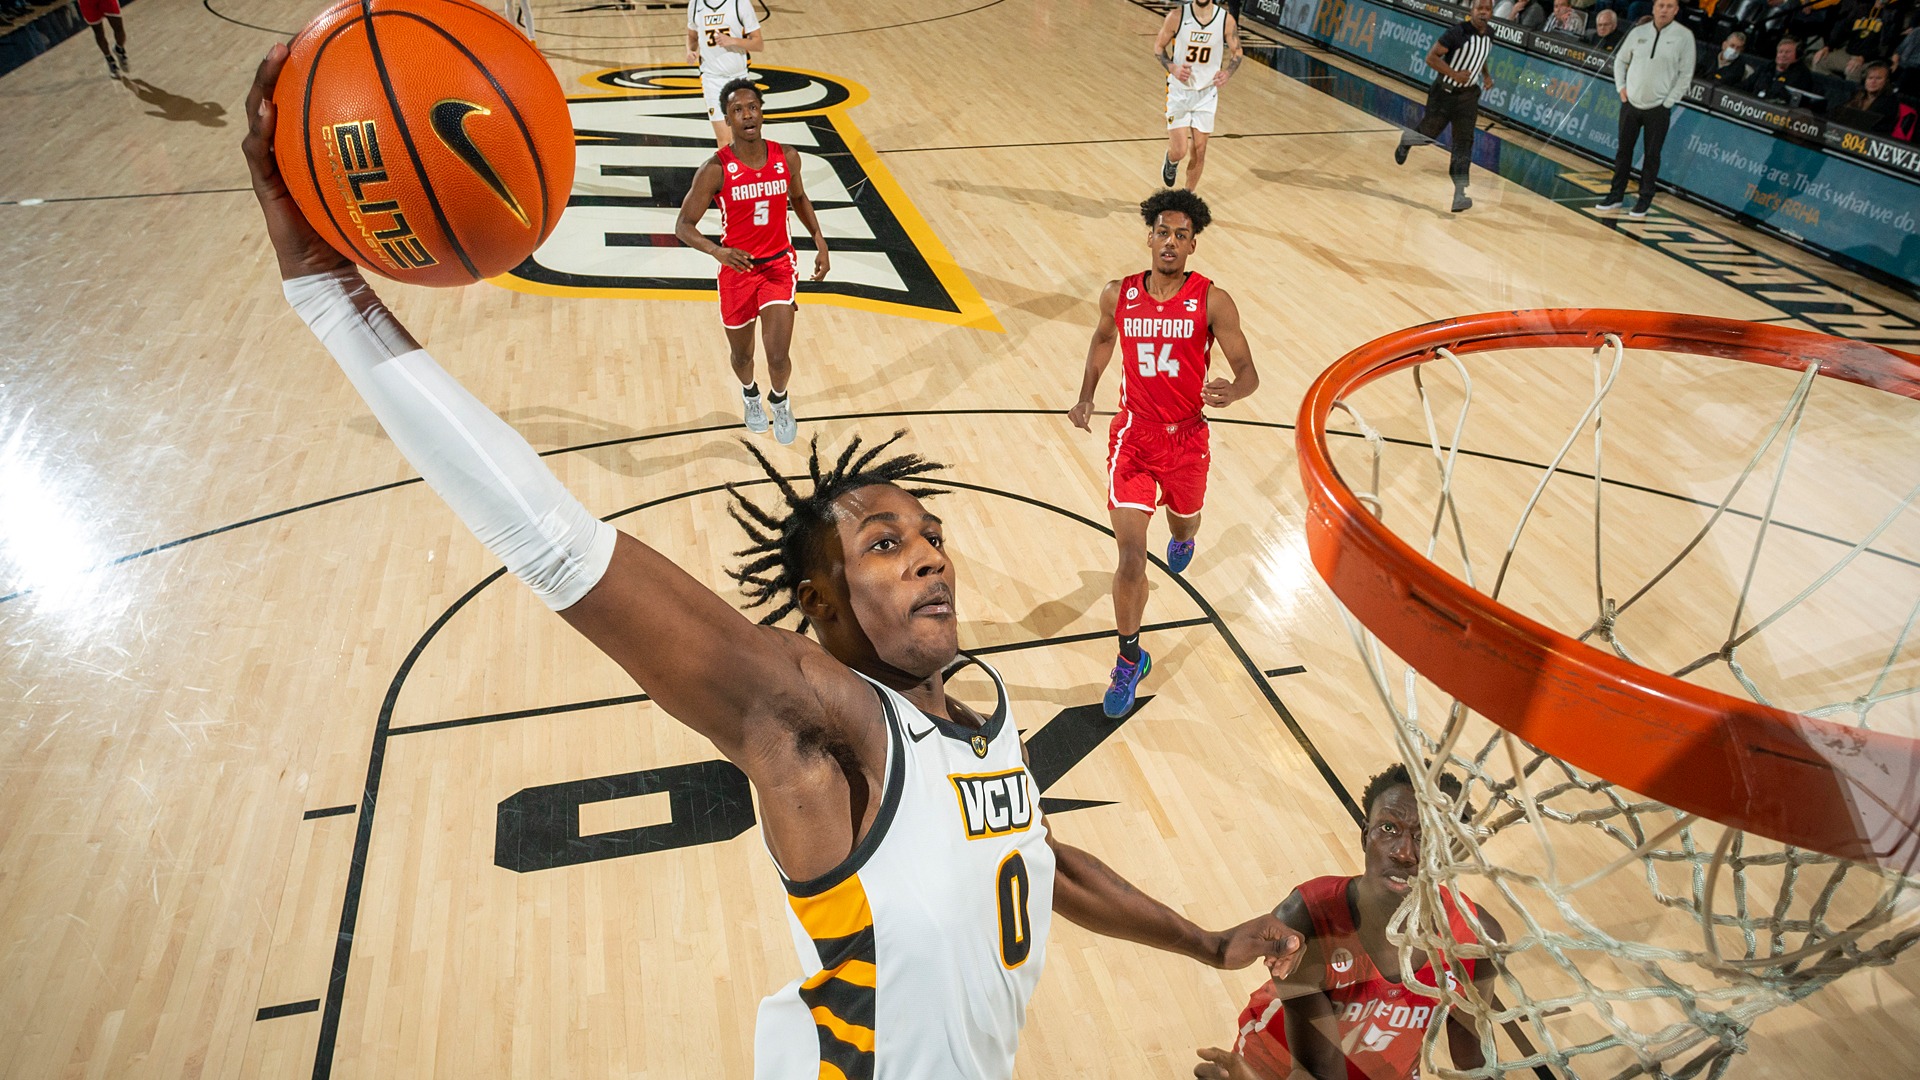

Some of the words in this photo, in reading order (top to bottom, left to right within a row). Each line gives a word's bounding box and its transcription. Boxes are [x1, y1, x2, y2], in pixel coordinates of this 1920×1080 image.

[704, 14, 725, 26] VCU
[1190, 31, 1212, 43] VCU
[1312, 0, 1377, 53] RRHA
[1379, 19, 1434, 51] provides
[1185, 45, 1211, 63] 30
[1534, 37, 1606, 68] findyournest.com
[1545, 77, 1583, 105] and
[1508, 93, 1533, 118] we
[1533, 102, 1589, 138] serve!
[1720, 94, 1819, 138] findyournest.com
[1841, 132, 1920, 173] 804.NEW.H
[322, 125, 399, 270] CHAMPIONSHIP
[333, 119, 440, 270] ELITE
[731, 179, 788, 201] RADFORD
[1687, 133, 1720, 161] That's
[1721, 147, 1748, 171] who
[1748, 160, 1767, 179] we
[1767, 167, 1790, 187] are.
[1793, 172, 1832, 201] That's
[1832, 188, 1871, 218] what
[1869, 205, 1893, 225] we
[1894, 209, 1917, 235] do.
[1743, 183, 1780, 211] That's
[1780, 198, 1820, 226] RRHA
[753, 200, 770, 226] 5
[1124, 317, 1194, 339] RADFORD
[1137, 342, 1180, 378] 54
[952, 771, 1032, 837] VCU
[996, 849, 1031, 971] 0
